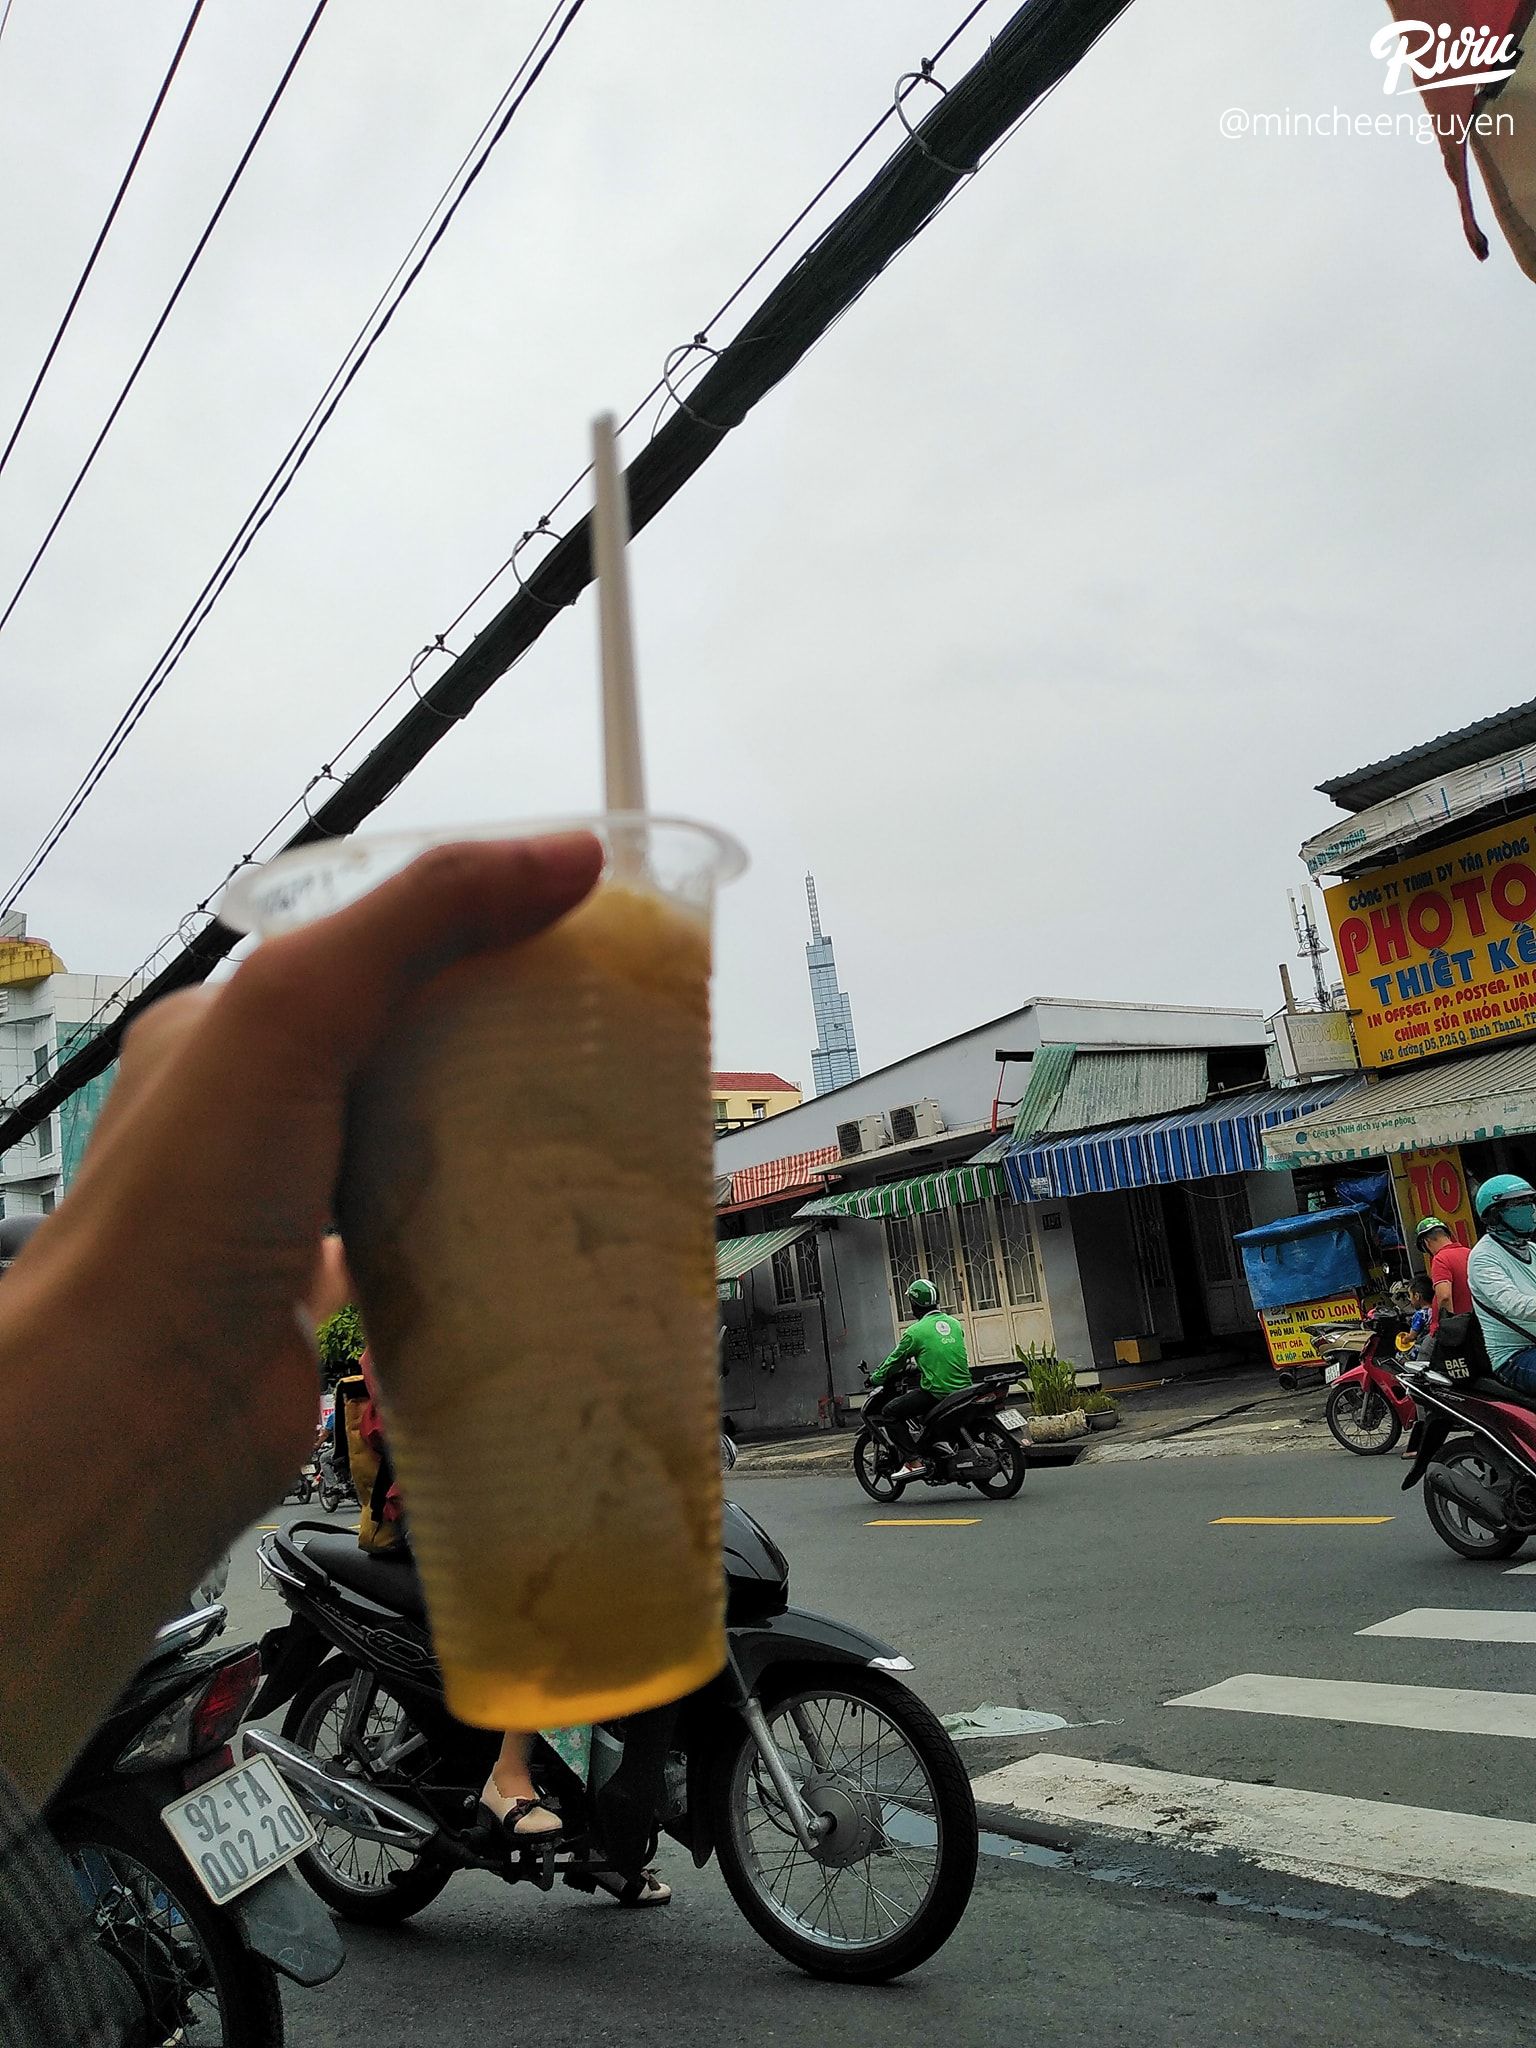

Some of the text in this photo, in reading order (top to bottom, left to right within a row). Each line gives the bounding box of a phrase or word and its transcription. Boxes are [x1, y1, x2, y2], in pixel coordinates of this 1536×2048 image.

[1383, 881, 1400, 899] TY
[1487, 836, 1530, 865] PHÒNG
[1338, 862, 1536, 976] PHOTO
[1370, 922, 1536, 1006] THIẾT KẾ
[1367, 1014, 1383, 1029] IN
[1385, 1001, 1431, 1023] OFFSET,
[1434, 994, 1453, 1011] PP,
[1455, 979, 1510, 1005] POSTER,
[1513, 972, 1530, 988] IN
[1435, 1011, 1460, 1033] SỬA
[1463, 1001, 1501, 1025] KHÓA
[1470, 1023, 1492, 1040] Bình
[1328, 1303, 1357, 1318] LOAN
[1272, 1340, 1288, 1351] THỊT
[1283, 1325, 1295, 1337] MAI
[1444, 1357, 1468, 1370] BAE
[200, 1804, 305, 1899] 002.20
